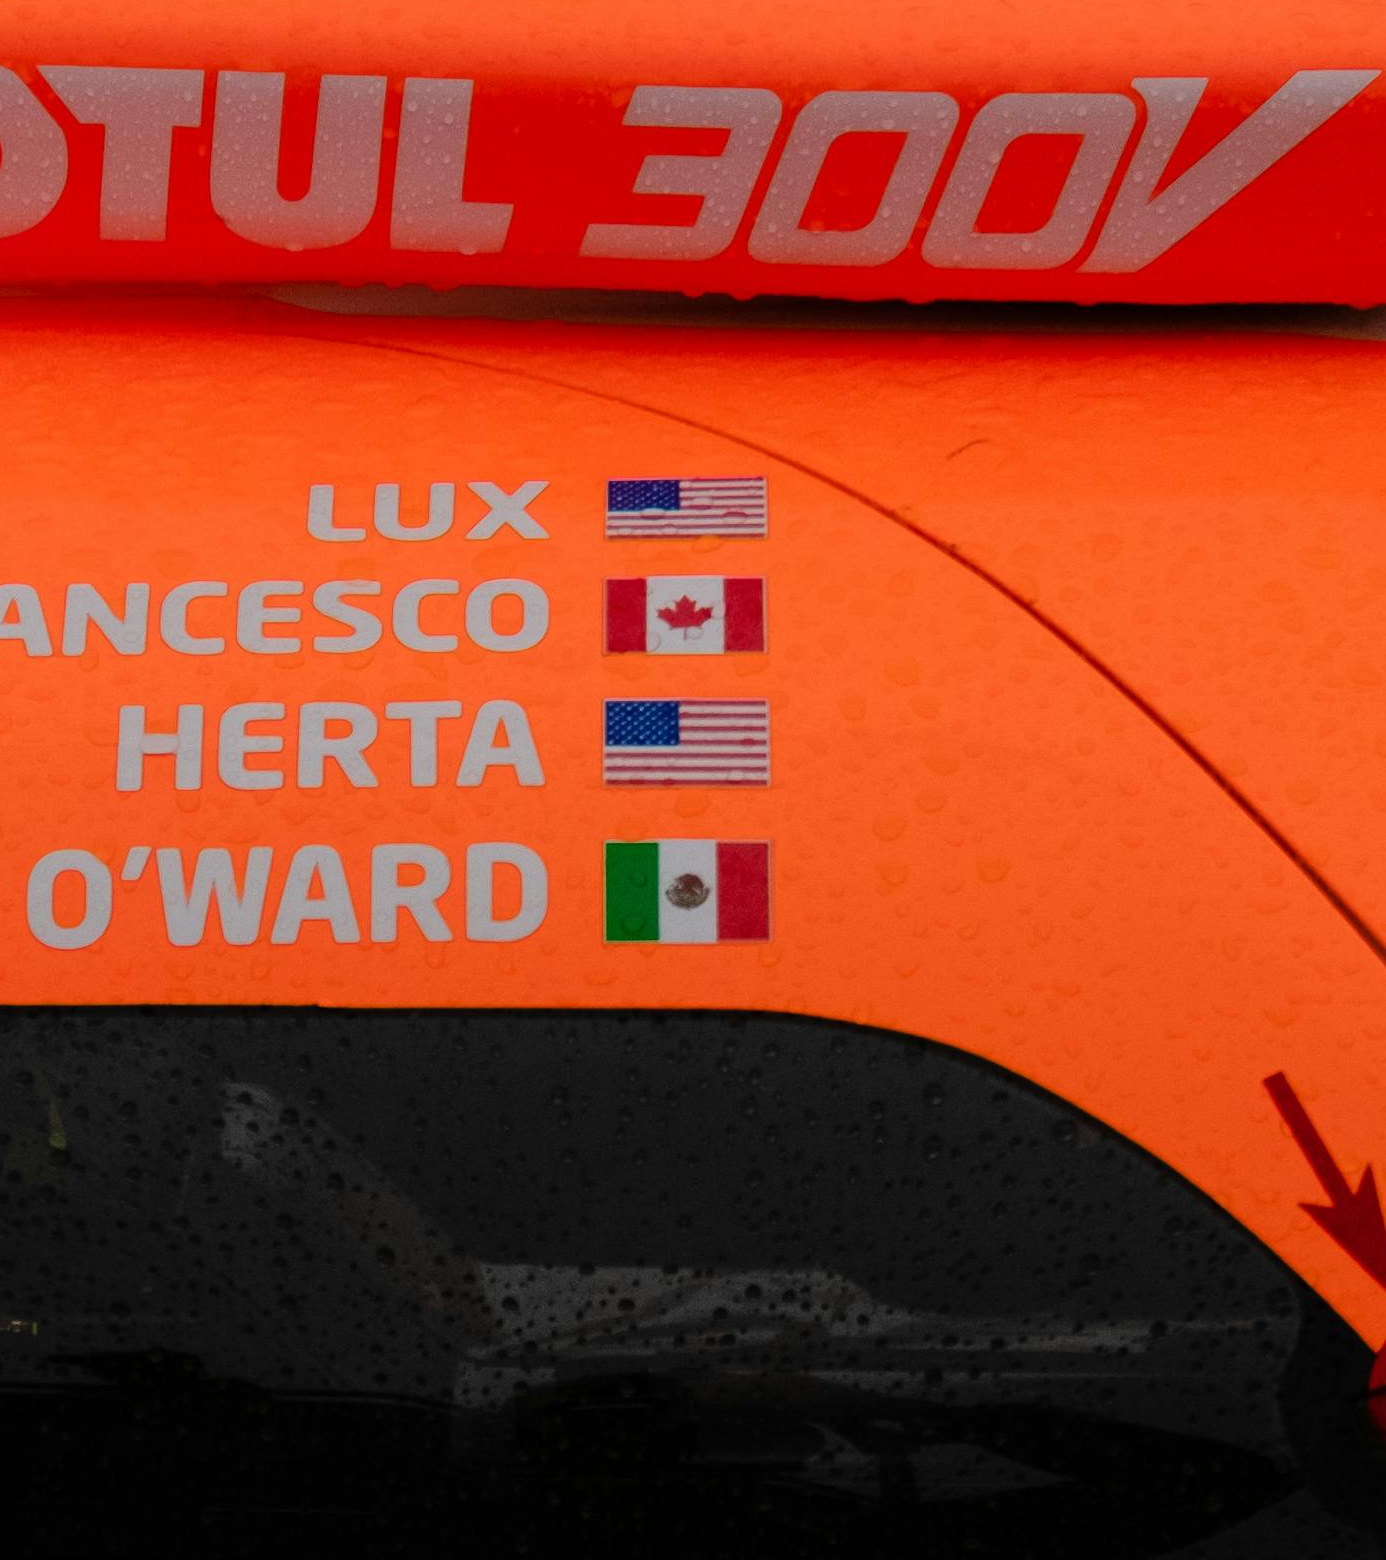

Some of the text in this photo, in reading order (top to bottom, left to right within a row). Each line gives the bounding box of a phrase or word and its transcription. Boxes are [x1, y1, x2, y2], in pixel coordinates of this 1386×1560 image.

[579, 70, 1383, 274] 300V
[308, 481, 551, 541] LUX
[116, 699, 546, 792] HERTA
[26, 841, 550, 949] O'WARD
